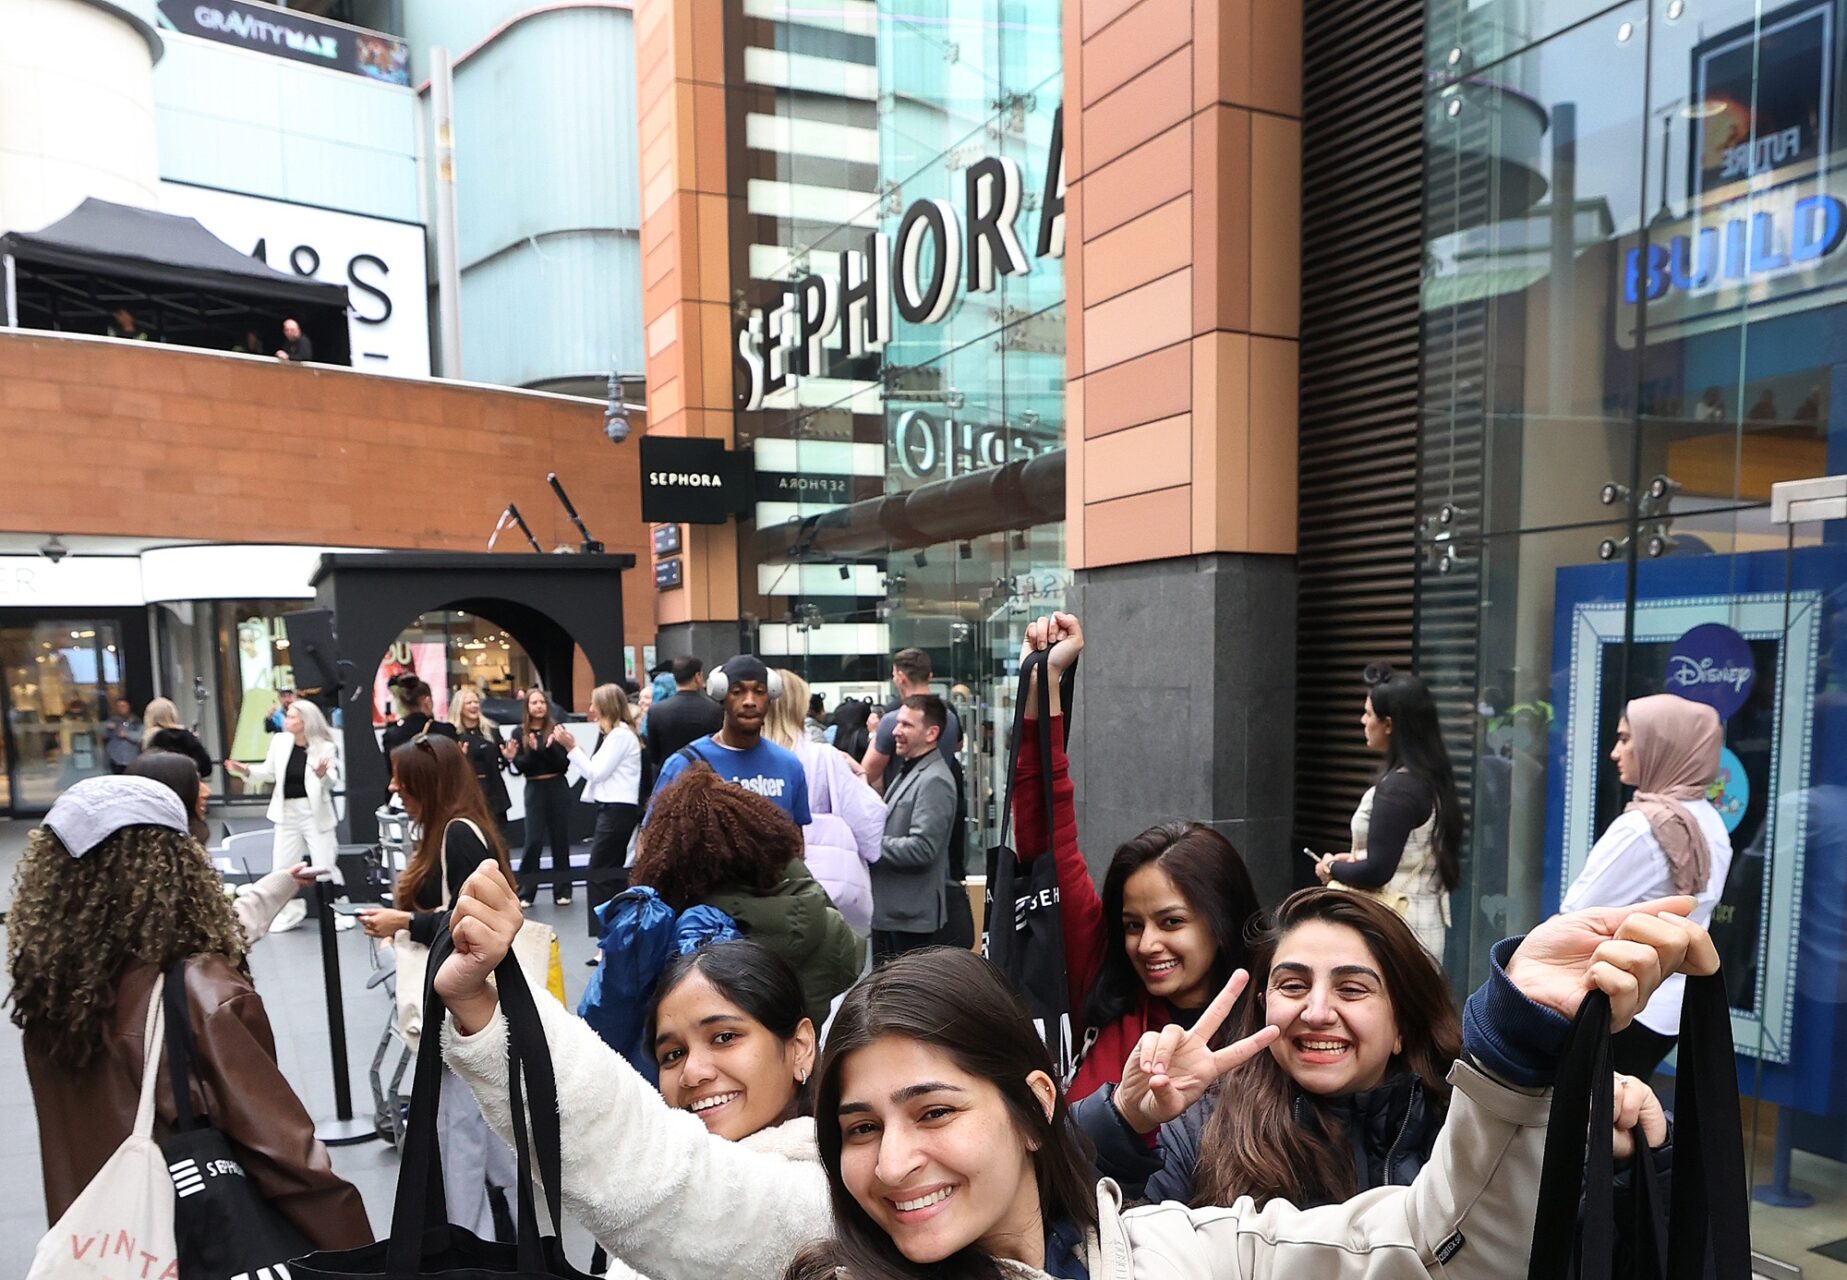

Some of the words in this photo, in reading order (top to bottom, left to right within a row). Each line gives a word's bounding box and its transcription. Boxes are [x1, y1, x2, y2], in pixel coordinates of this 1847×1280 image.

[1624, 194, 1843, 304] BUILD
[650, 472, 722, 488] SEPHORA
[732, 774, 785, 797] asker
